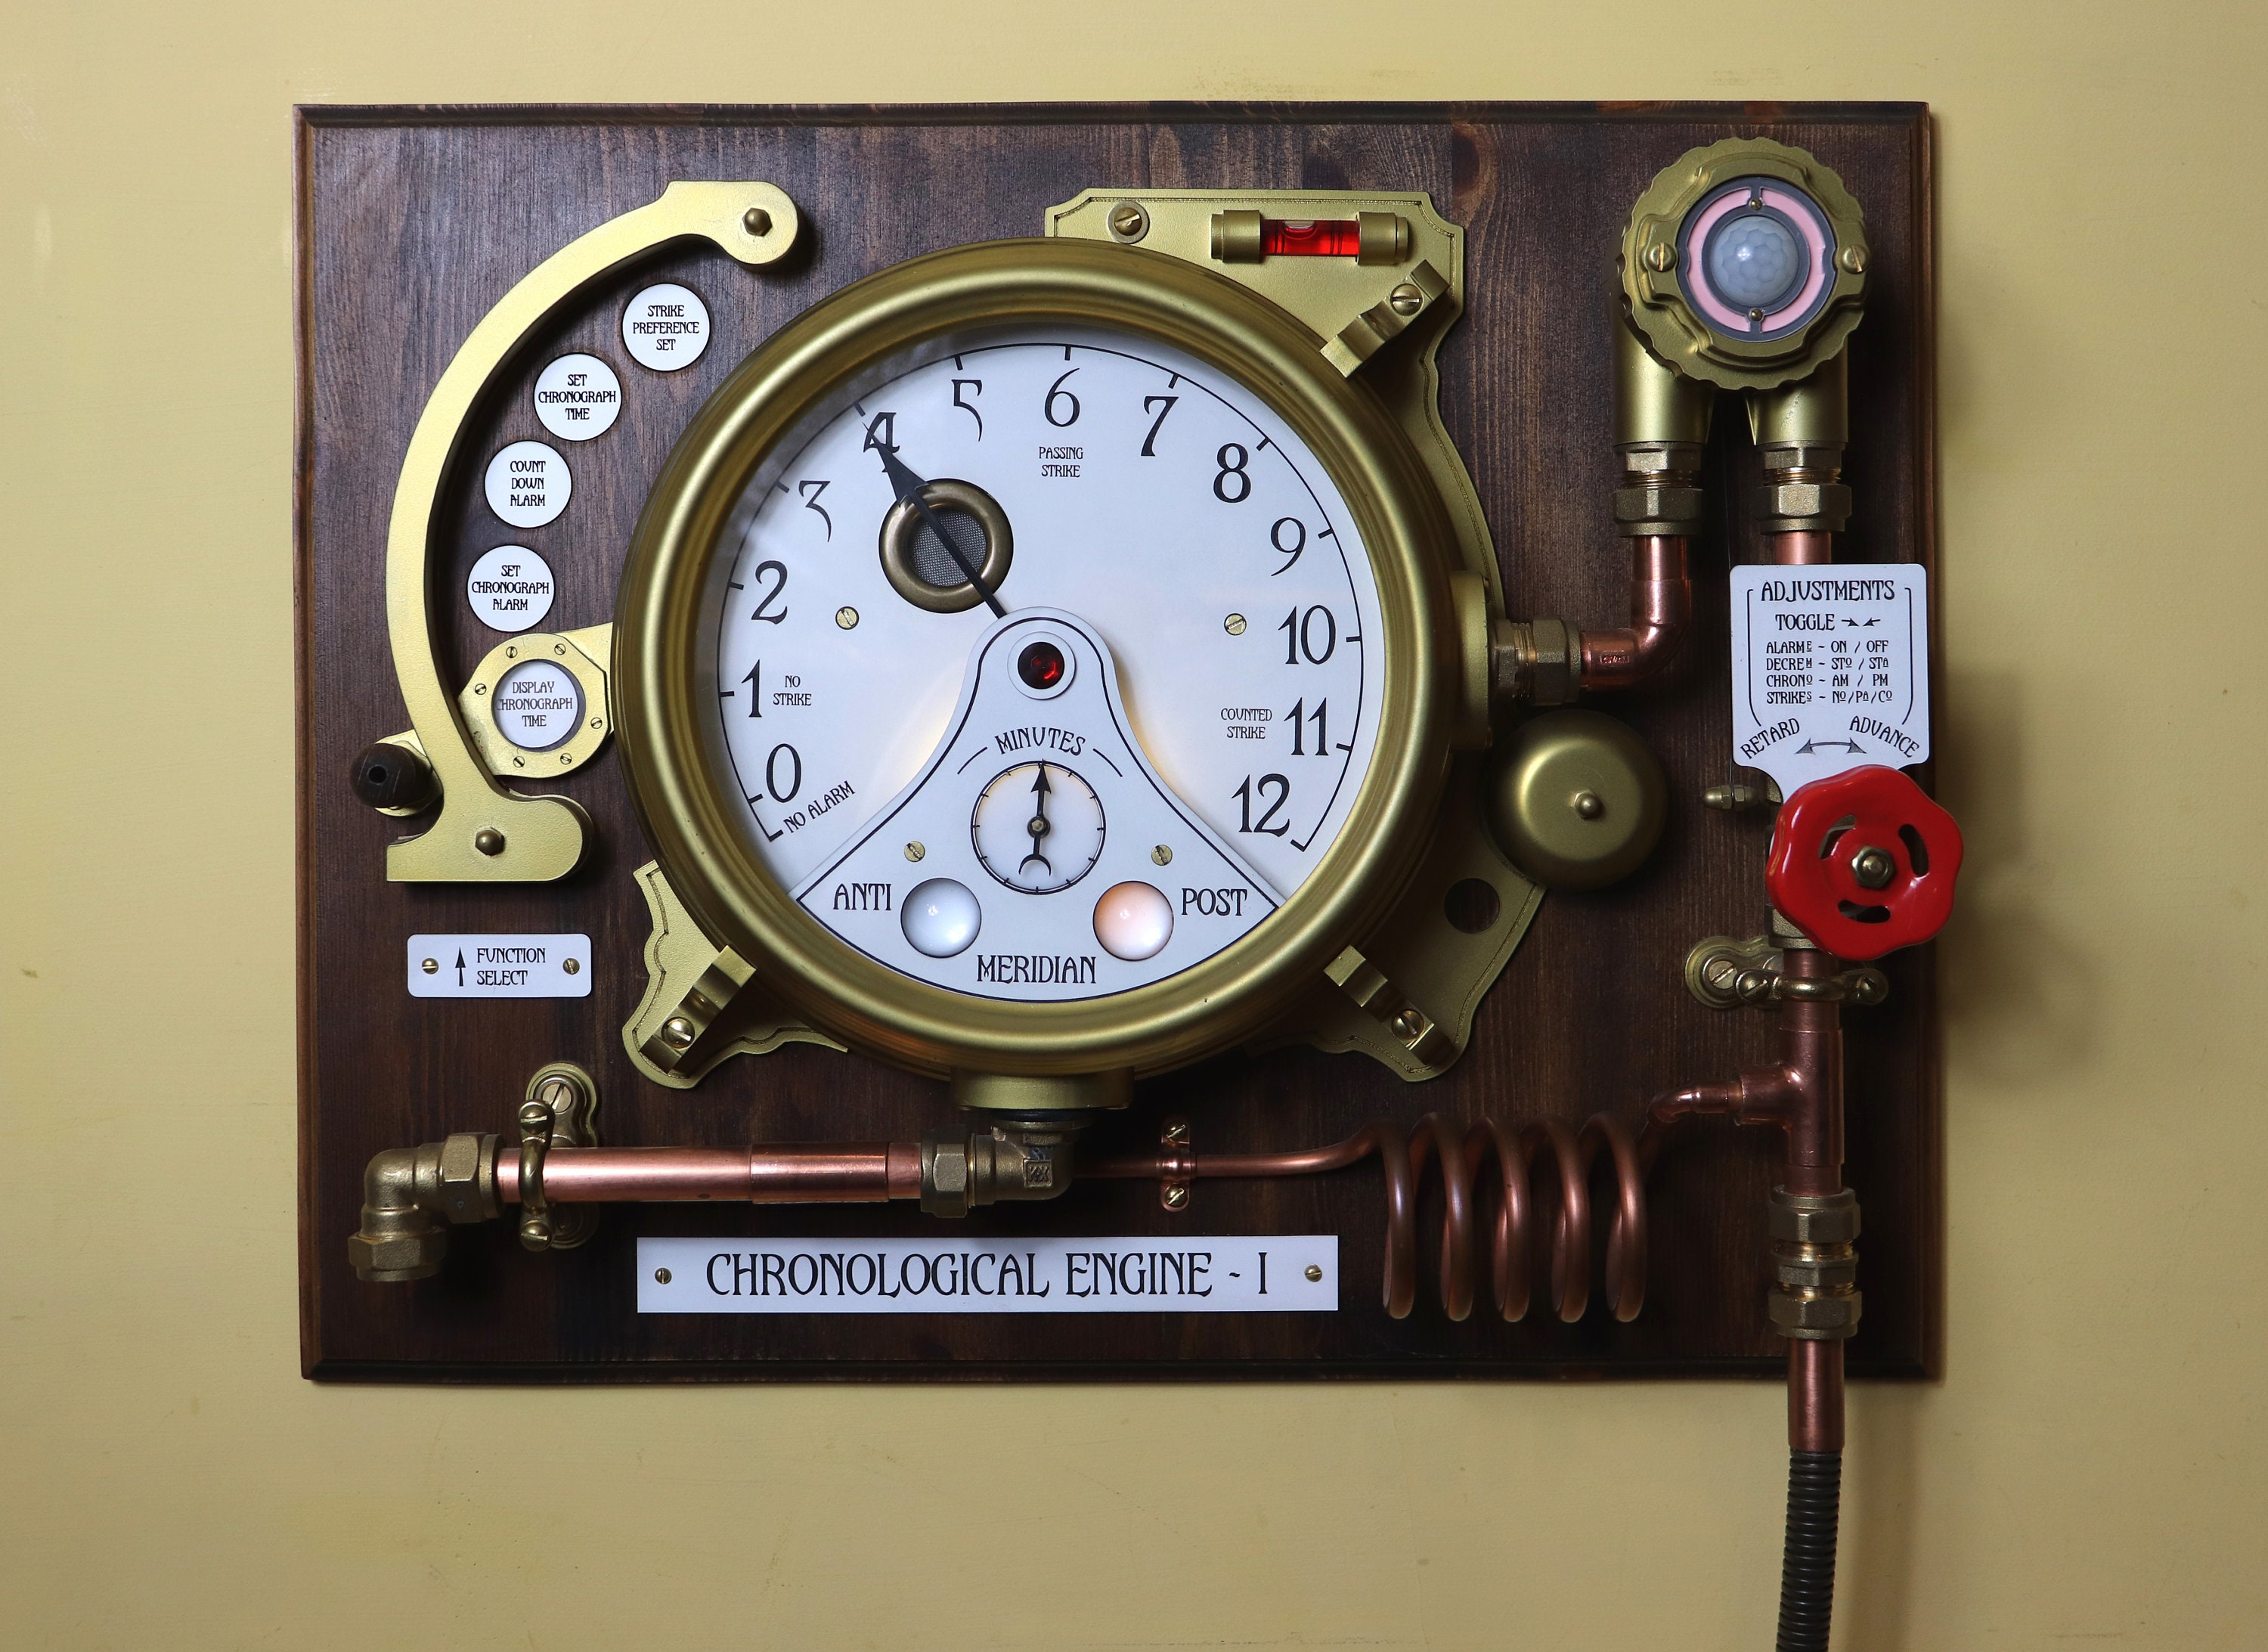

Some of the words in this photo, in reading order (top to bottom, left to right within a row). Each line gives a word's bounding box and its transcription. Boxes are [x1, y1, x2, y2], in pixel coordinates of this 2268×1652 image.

[648, 305, 684, 317] STRIKE
[634, 322, 699, 333] PREFERENCE
[656, 339, 676, 350] SET
[568, 374, 587, 386] SET
[538, 391, 615, 403] CHRONOGRAPH
[1045, 368, 1080, 427] 6
[565, 408, 589, 420] TIME
[952, 380, 982, 441] 5
[1141, 396, 1179, 456] 7
[863, 412, 900, 473] 4
[1040, 447, 1083, 459] PASSING
[510, 461, 546, 472] COUNT
[1042, 465, 1080, 477] STRIKE
[1213, 443, 1250, 503] 8
[512, 478, 544, 489] DOWN
[510, 494, 544, 506] ALARM
[799, 480, 831, 542] 3
[1271, 517, 1306, 576] 9
[501, 566, 520, 577] SET
[472, 581, 549, 594] CHRONOGRAPH
[751, 561, 787, 625] 2
[1761, 581, 1895, 602] ADJUSTMENTS
[493, 599, 528, 610] ALARM
[1775, 614, 1835, 631] TOGGLE
[1278, 605, 1336, 665] 10
[1831, 641, 1846, 652] ON
[1867, 640, 1888, 652] OFF
[513, 681, 555, 693] DISPLAY
[785, 676, 801, 687] NO
[1833, 674, 1848, 687] AM
[1873, 674, 1888, 686] PM
[742, 659, 762, 718] 1
[496, 698, 572, 710] CHRONOGRAPH
[773, 693, 811, 705] STRIKE
[522, 715, 546, 727] TIME
[1221, 708, 1272, 721] COUNTED
[1227, 727, 1266, 739] STRIKE
[1284, 697, 1328, 755] 11
[994, 727, 1086, 757] MINUTES
[1740, 718, 1799, 759] RETARD
[1849, 715, 1919, 758] ADVANCE
[767, 744, 801, 803] 0
[783, 811, 806, 833] NO
[808, 781, 855, 819] ALARM
[1232, 773, 1290, 837] 12
[833, 883, 891, 910] ANTI
[1182, 888, 1247, 916] POST
[478, 948, 545, 962] FUNCTION
[978, 955, 1095, 984] MERIDIAN
[477, 971, 528, 985] SELECT
[707, 1254, 1049, 1297] CHRONOLOGICAL
[1066, 1253, 1212, 1297] ENGINE
